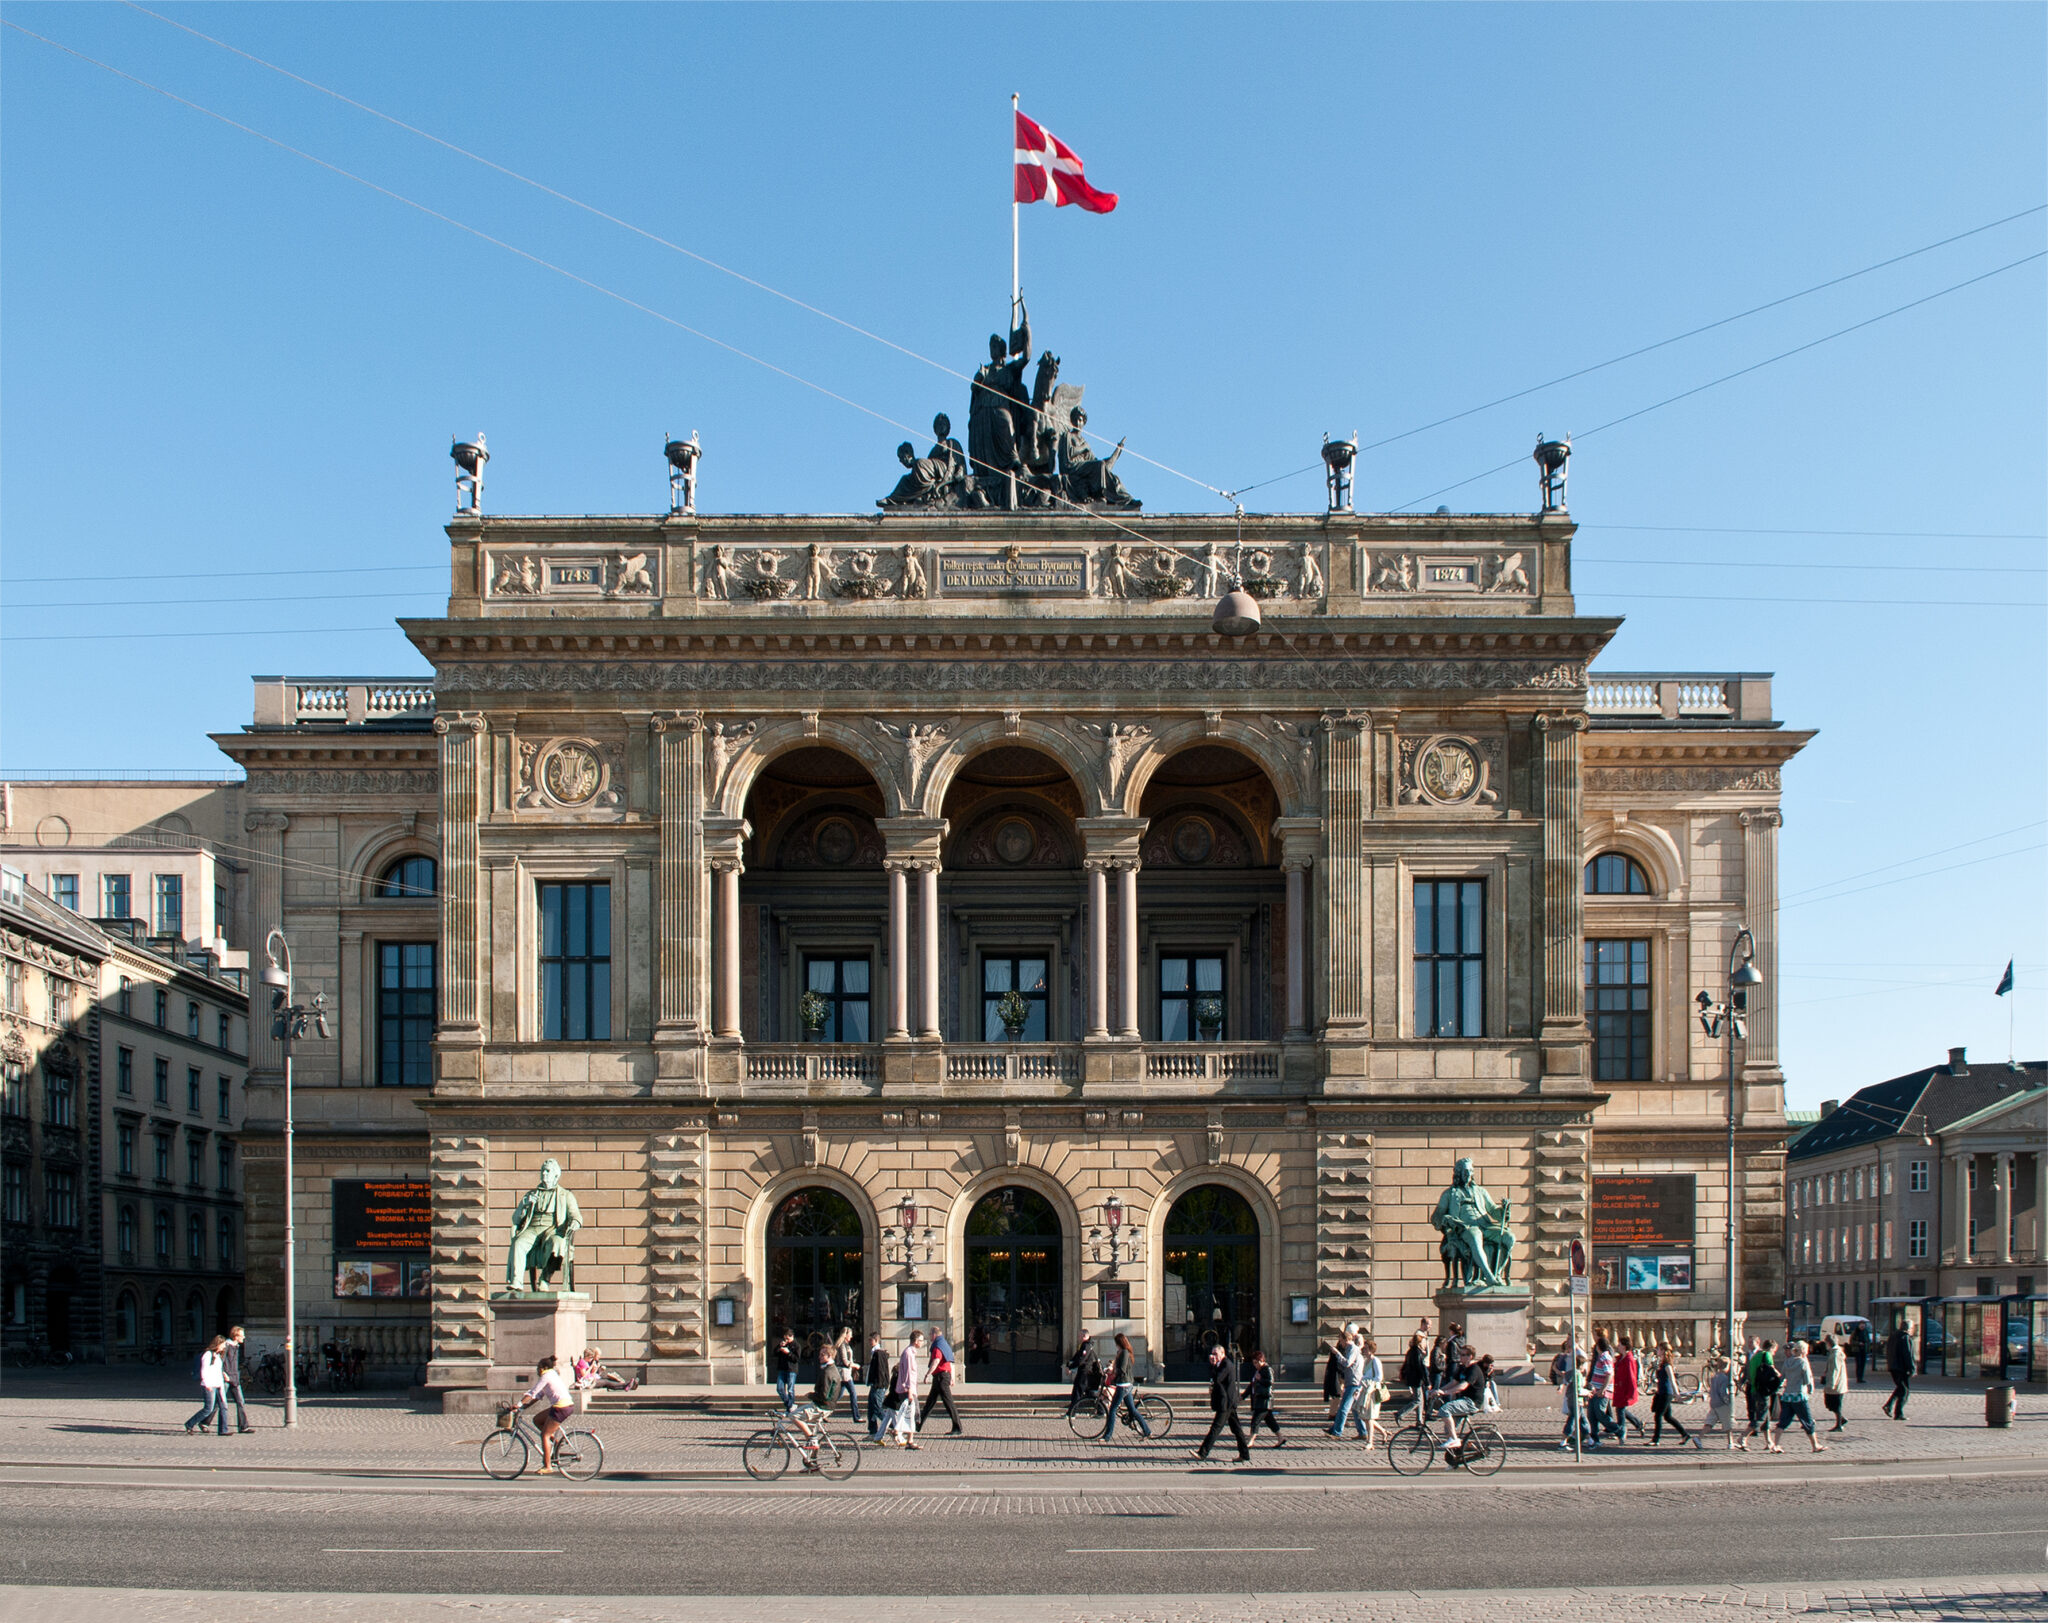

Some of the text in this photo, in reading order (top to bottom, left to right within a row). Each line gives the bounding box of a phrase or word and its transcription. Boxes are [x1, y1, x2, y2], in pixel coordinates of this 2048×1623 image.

[986, 559, 1005, 571] under
[560, 569, 590, 581] 1748
[1434, 568, 1464, 580] 1874
[946, 575, 1079, 586] DEN DANSKE SKUEPLADS
